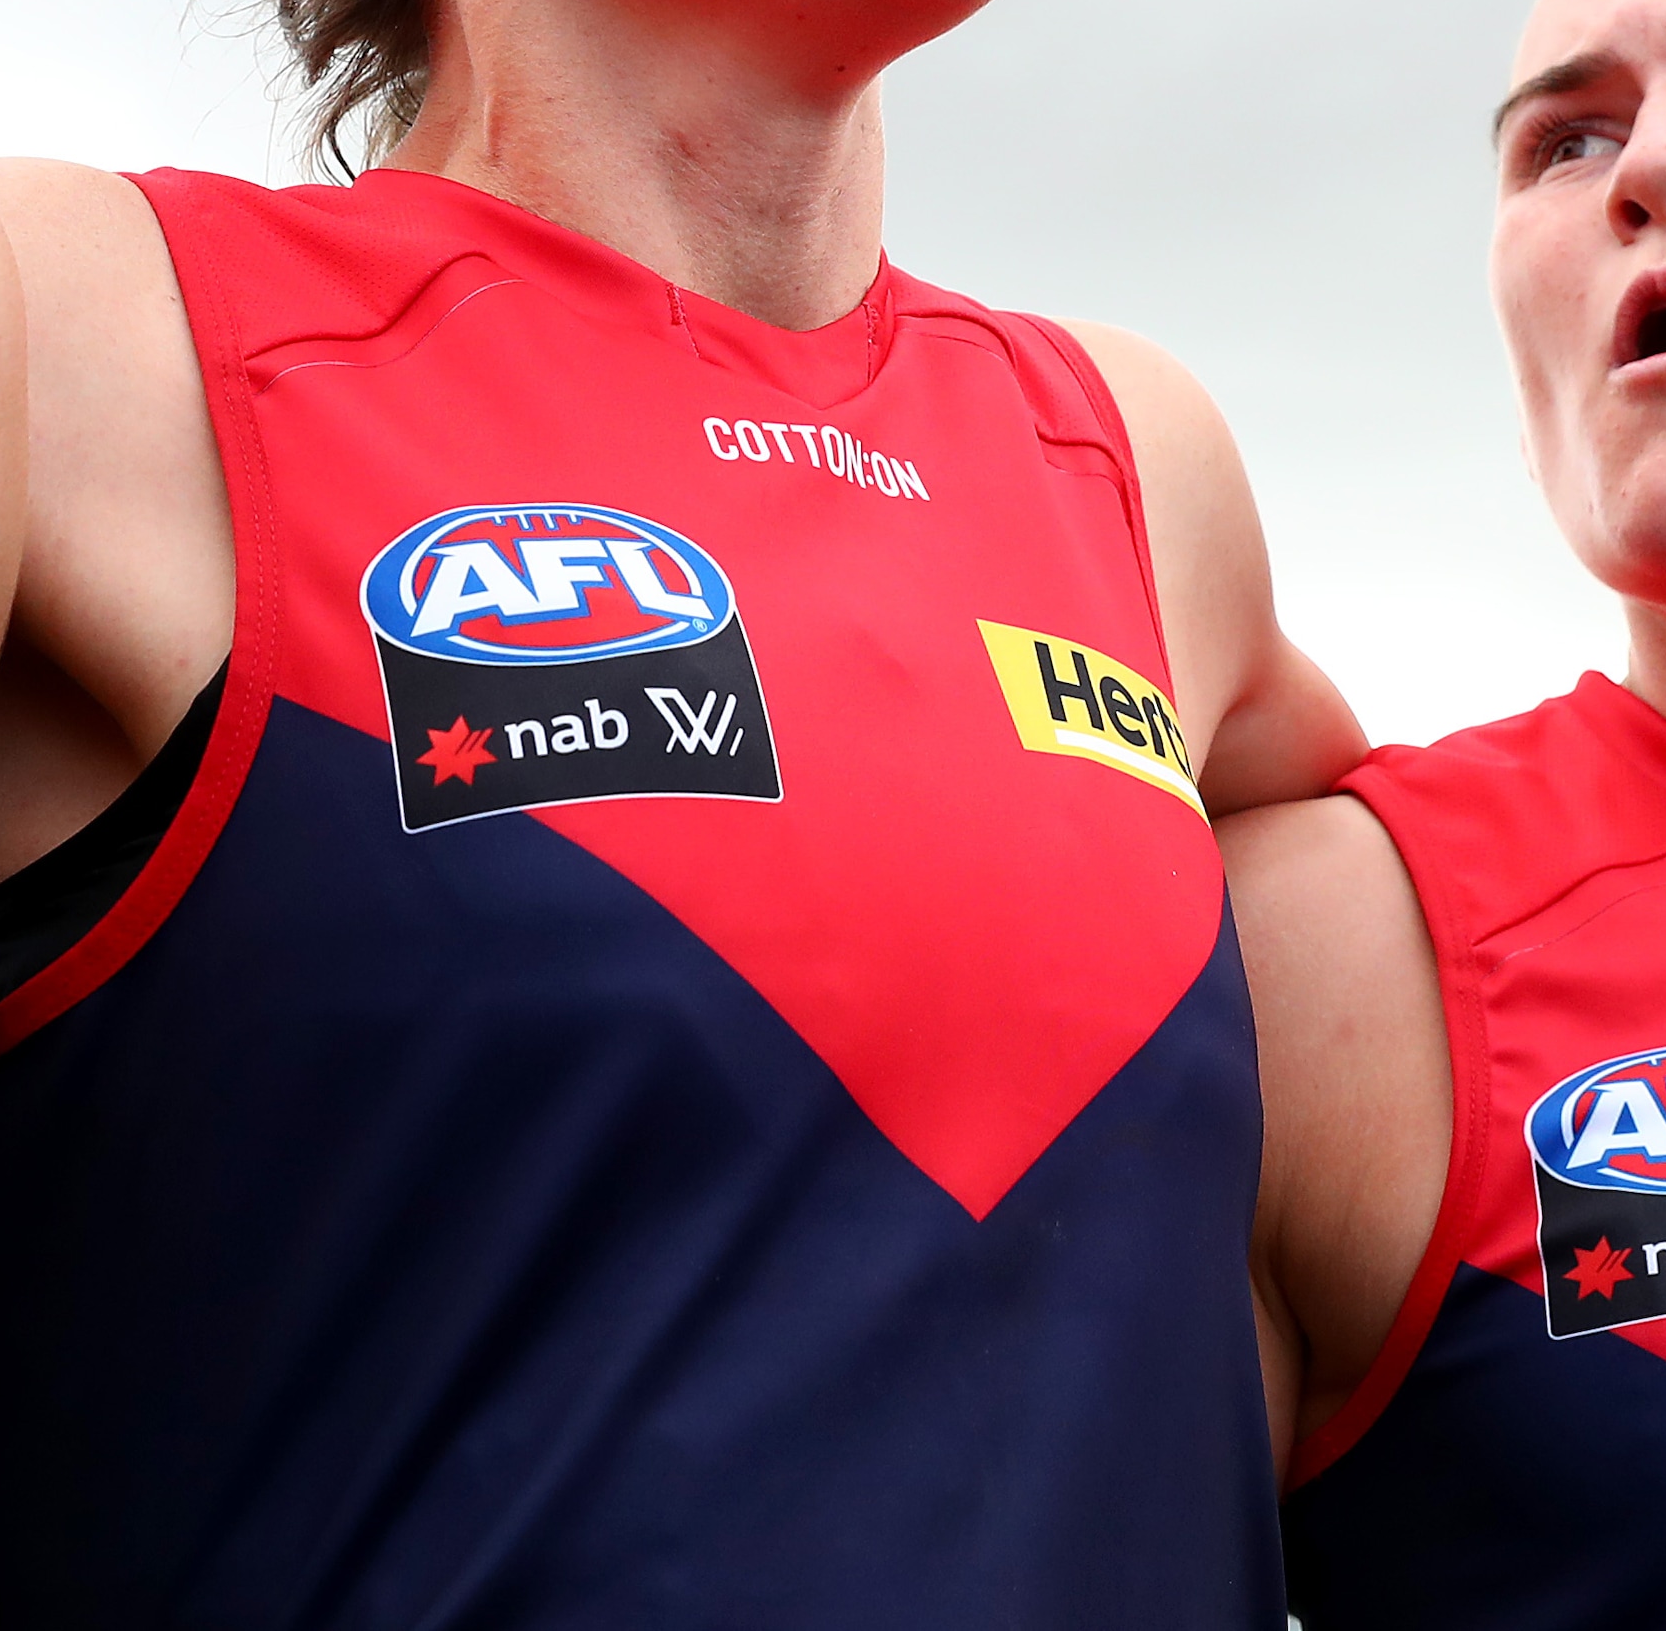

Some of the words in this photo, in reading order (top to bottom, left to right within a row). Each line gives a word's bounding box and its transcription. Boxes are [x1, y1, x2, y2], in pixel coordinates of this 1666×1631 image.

[702, 415, 932, 503] COTTON:ON
[410, 538, 715, 638] AFL
[503, 697, 629, 759] nab
